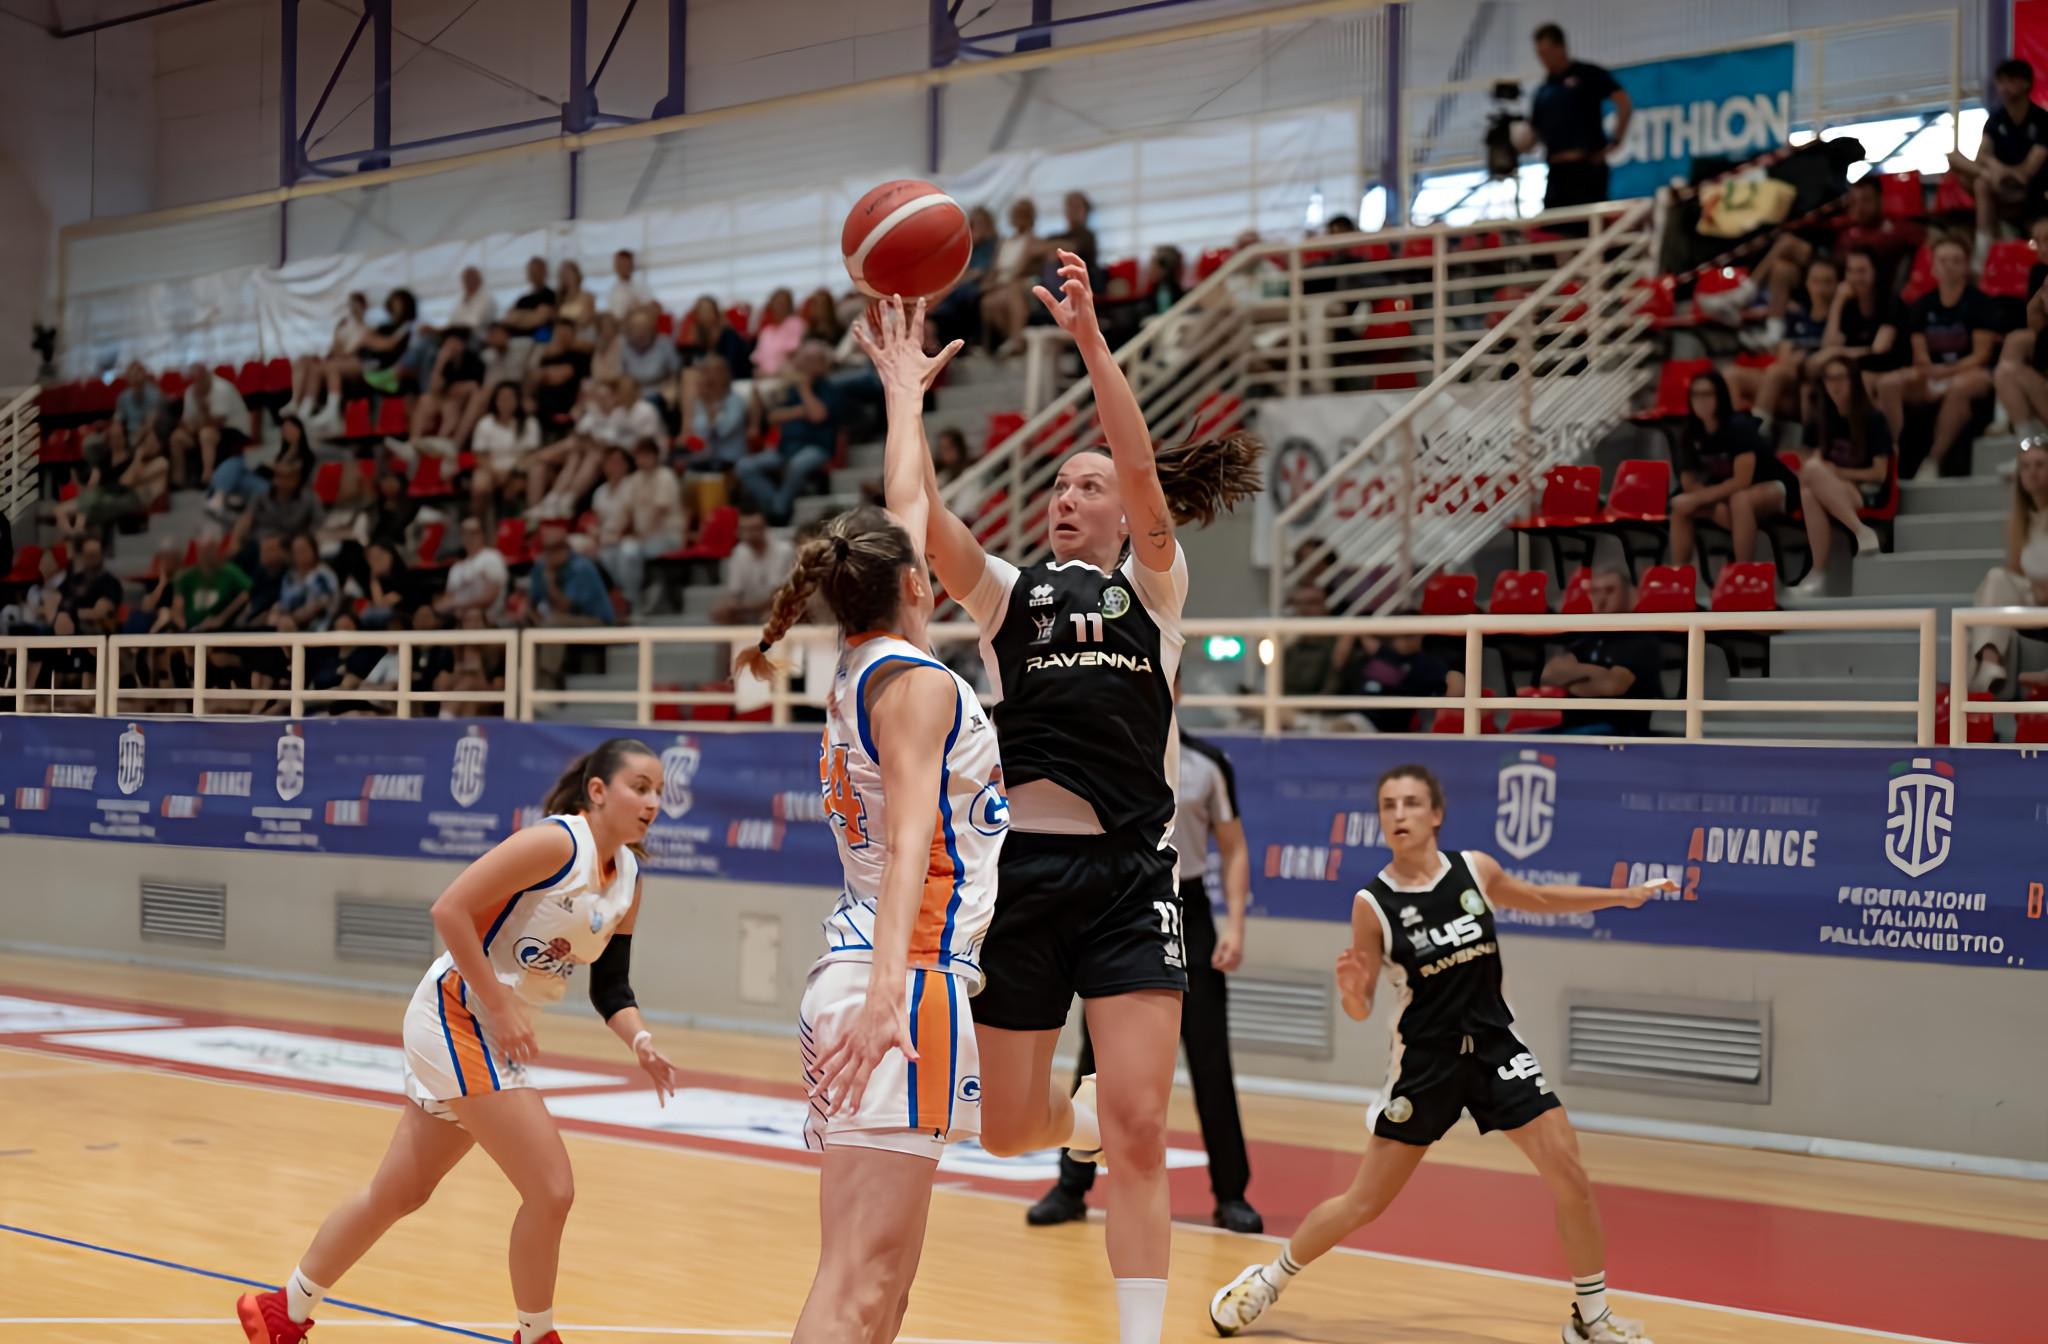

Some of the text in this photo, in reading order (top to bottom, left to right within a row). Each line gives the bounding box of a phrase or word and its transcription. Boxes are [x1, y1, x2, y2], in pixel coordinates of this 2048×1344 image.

[1070, 612, 1104, 642] 11
[1026, 651, 1153, 673] RAVENNA
[1688, 827, 1818, 867] ADVANCE
[1838, 886, 1986, 911] FEDERAZIONE
[1429, 914, 1483, 947] 45
[1862, 908, 1959, 929] ITALIANA
